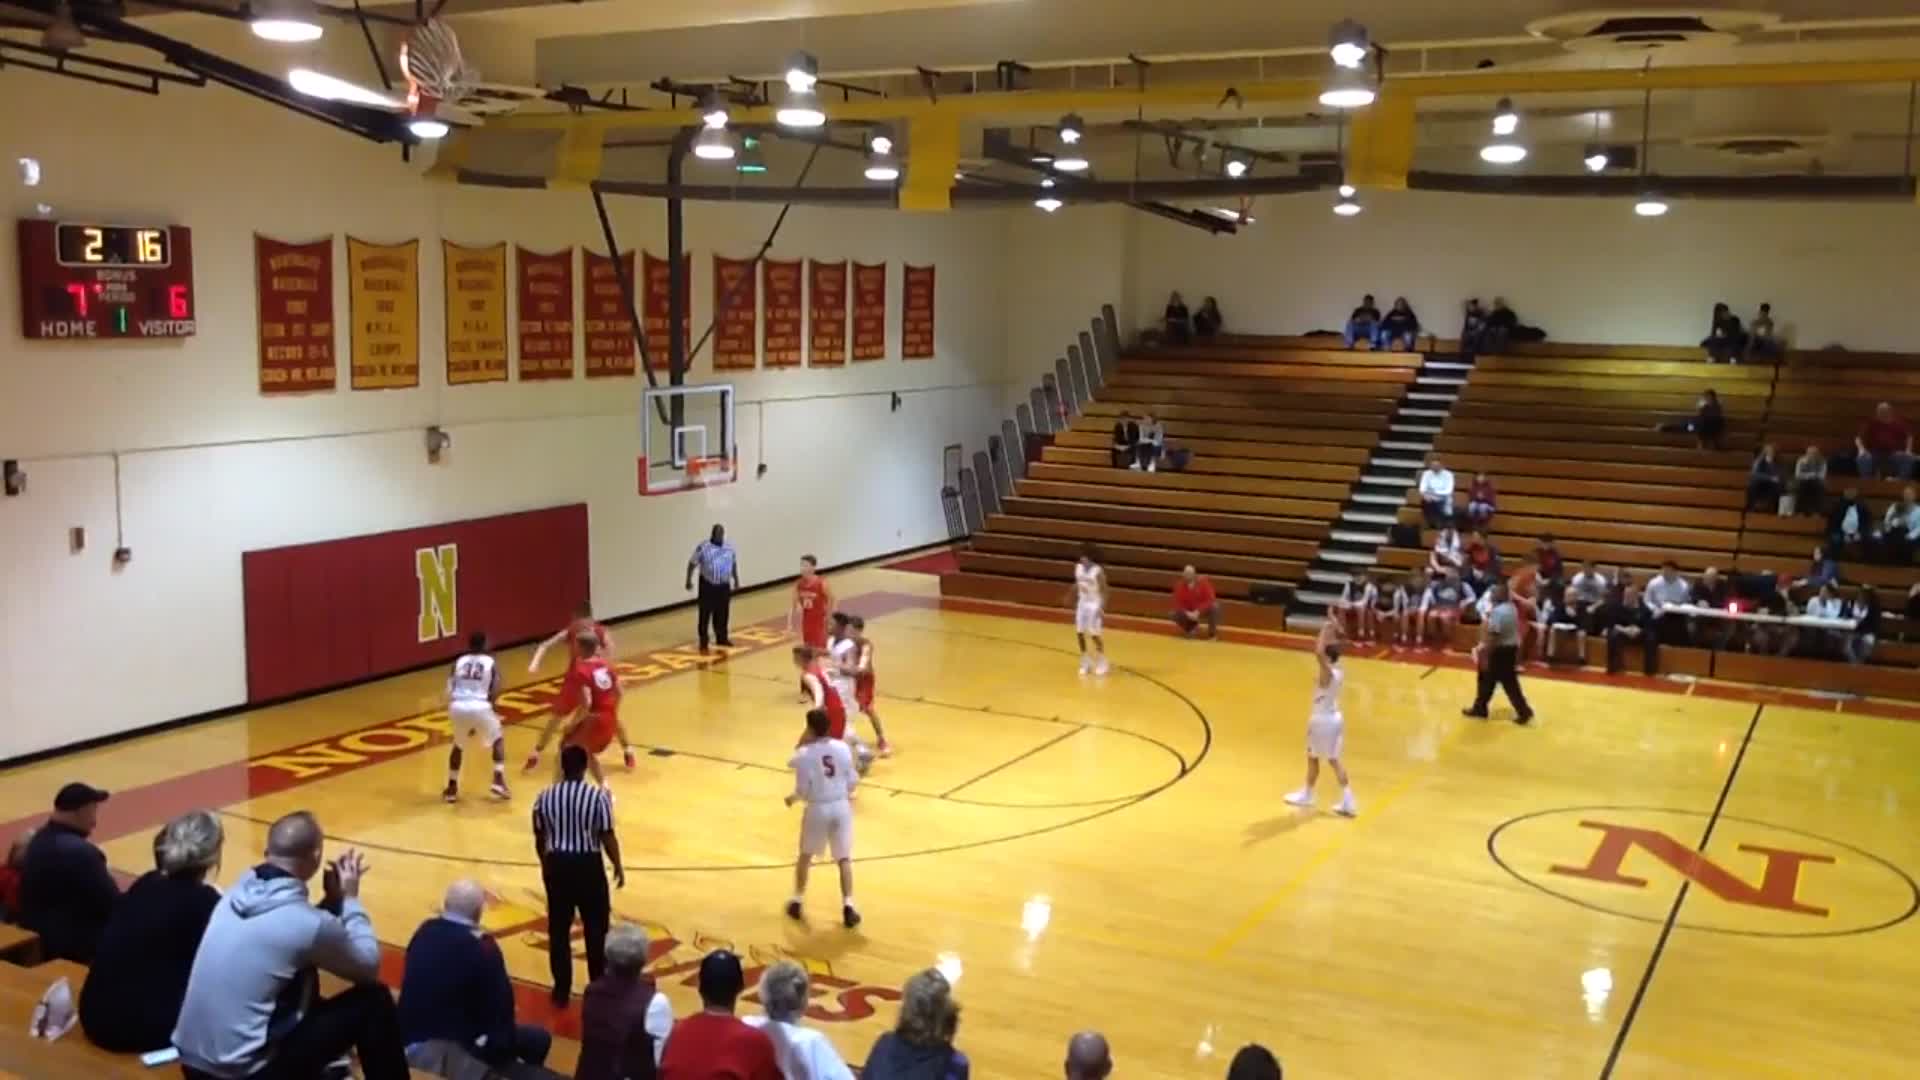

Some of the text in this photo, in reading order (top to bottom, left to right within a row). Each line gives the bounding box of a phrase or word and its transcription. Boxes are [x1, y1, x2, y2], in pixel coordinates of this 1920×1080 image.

[67, 283, 87, 317] 7
[168, 285, 188, 318] 6
[40, 321, 97, 336] HOME
[119, 307, 127, 333] 1
[138, 320, 197, 336] VISITOR
[416, 543, 458, 643] N
[462, 662, 485, 681] 32
[247, 625, 787, 778] NORTGATE
[821, 754, 836, 779] 5
[1549, 819, 1836, 918] N
